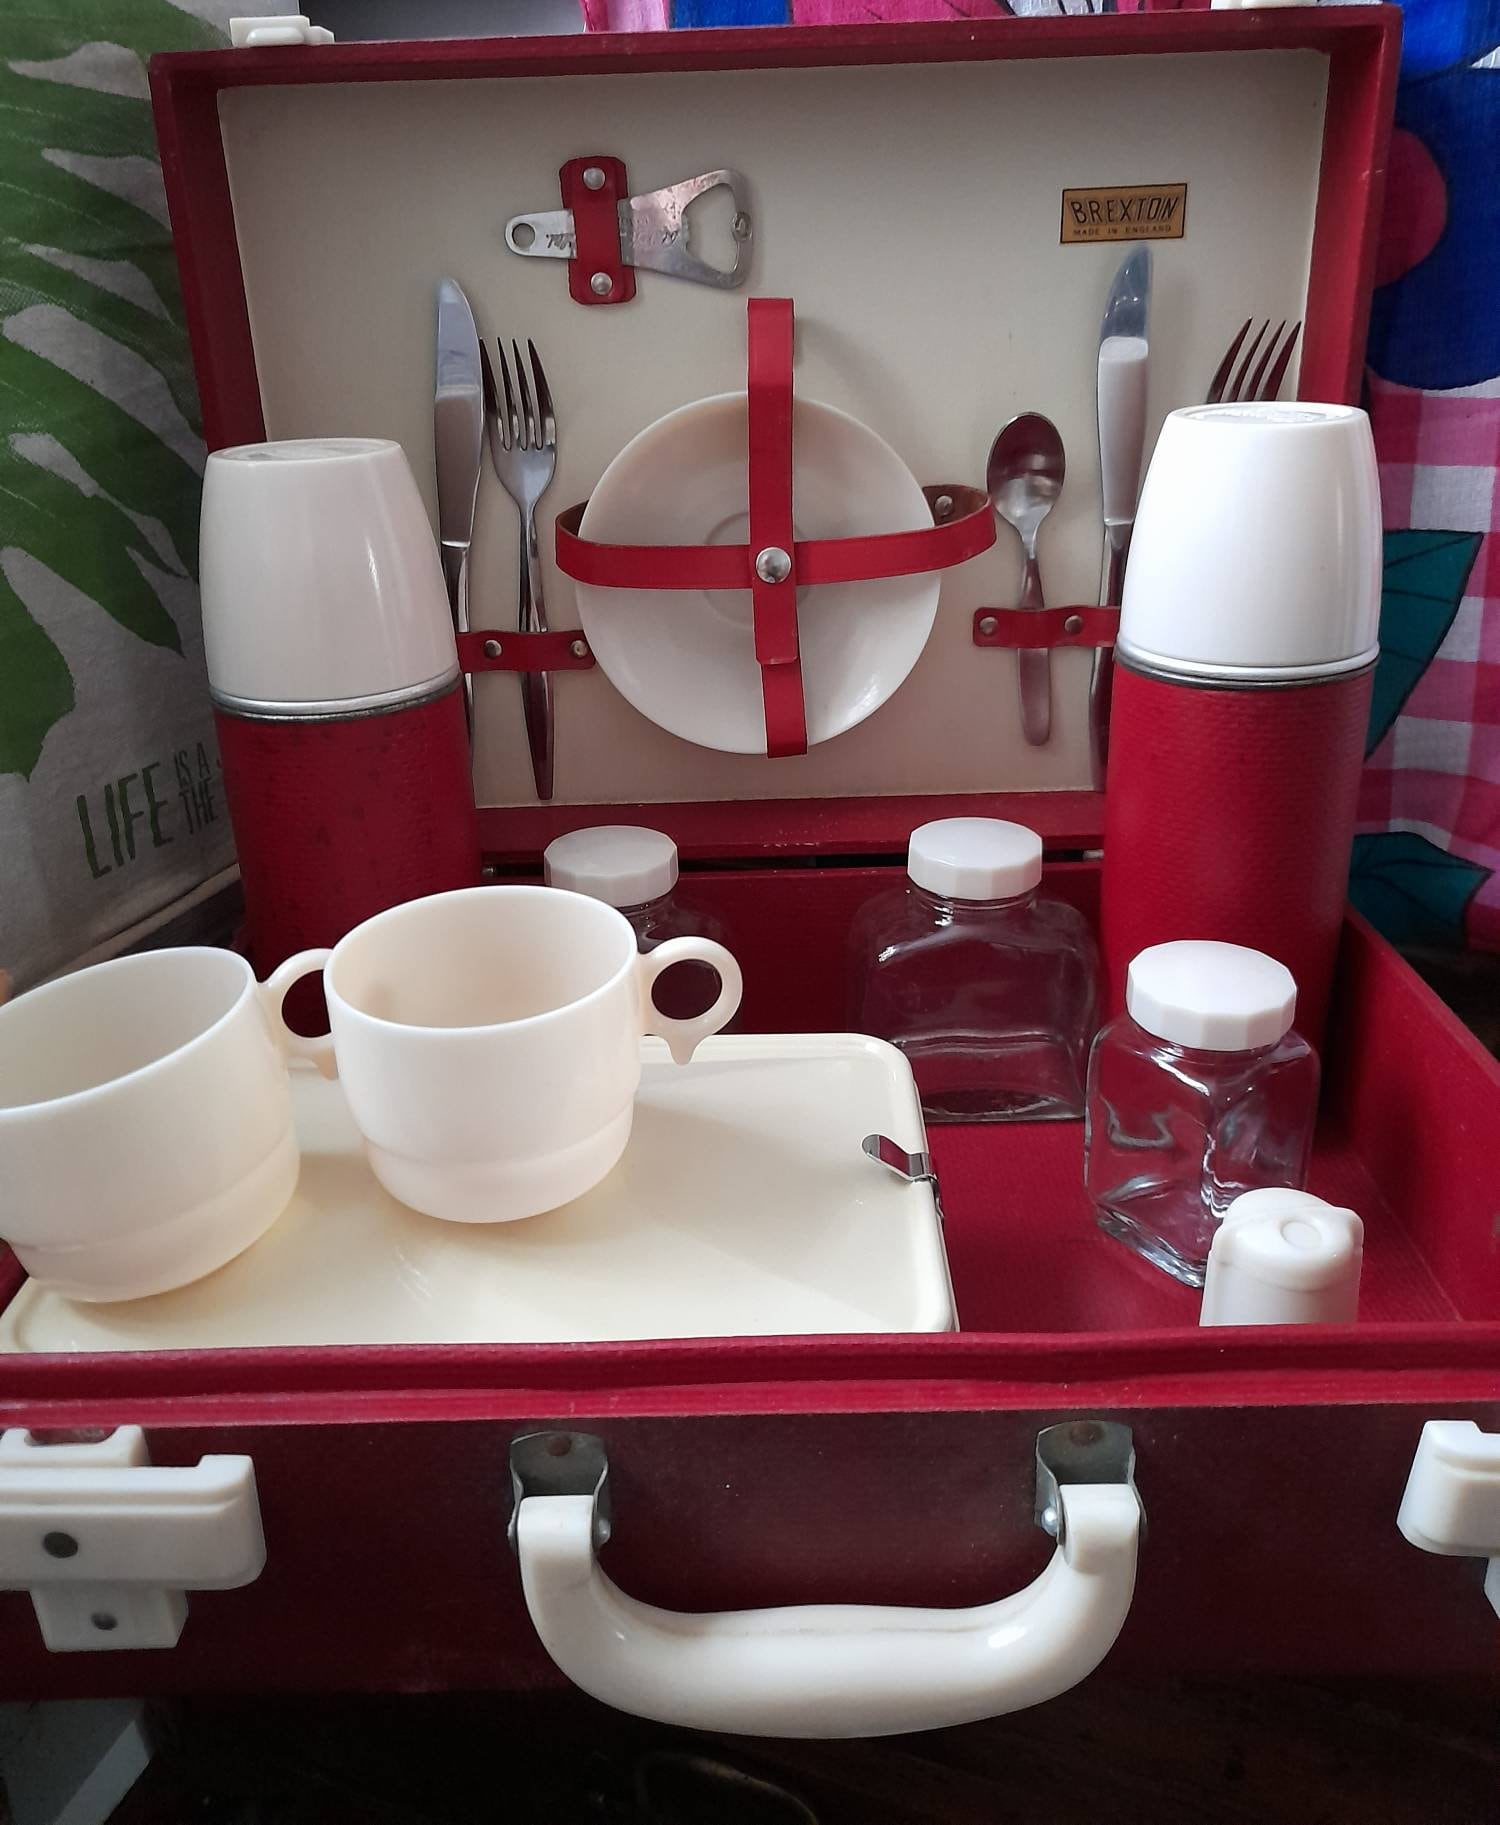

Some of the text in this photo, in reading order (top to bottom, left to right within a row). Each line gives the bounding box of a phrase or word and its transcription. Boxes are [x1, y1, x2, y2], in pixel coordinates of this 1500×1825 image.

[1071, 196, 1179, 223] BREXTON
[1073, 225, 1171, 236] MADE IN ENGLAND
[173, 742, 211, 789] IS A
[76, 762, 175, 880] LIFE
[179, 777, 218, 835] THE
